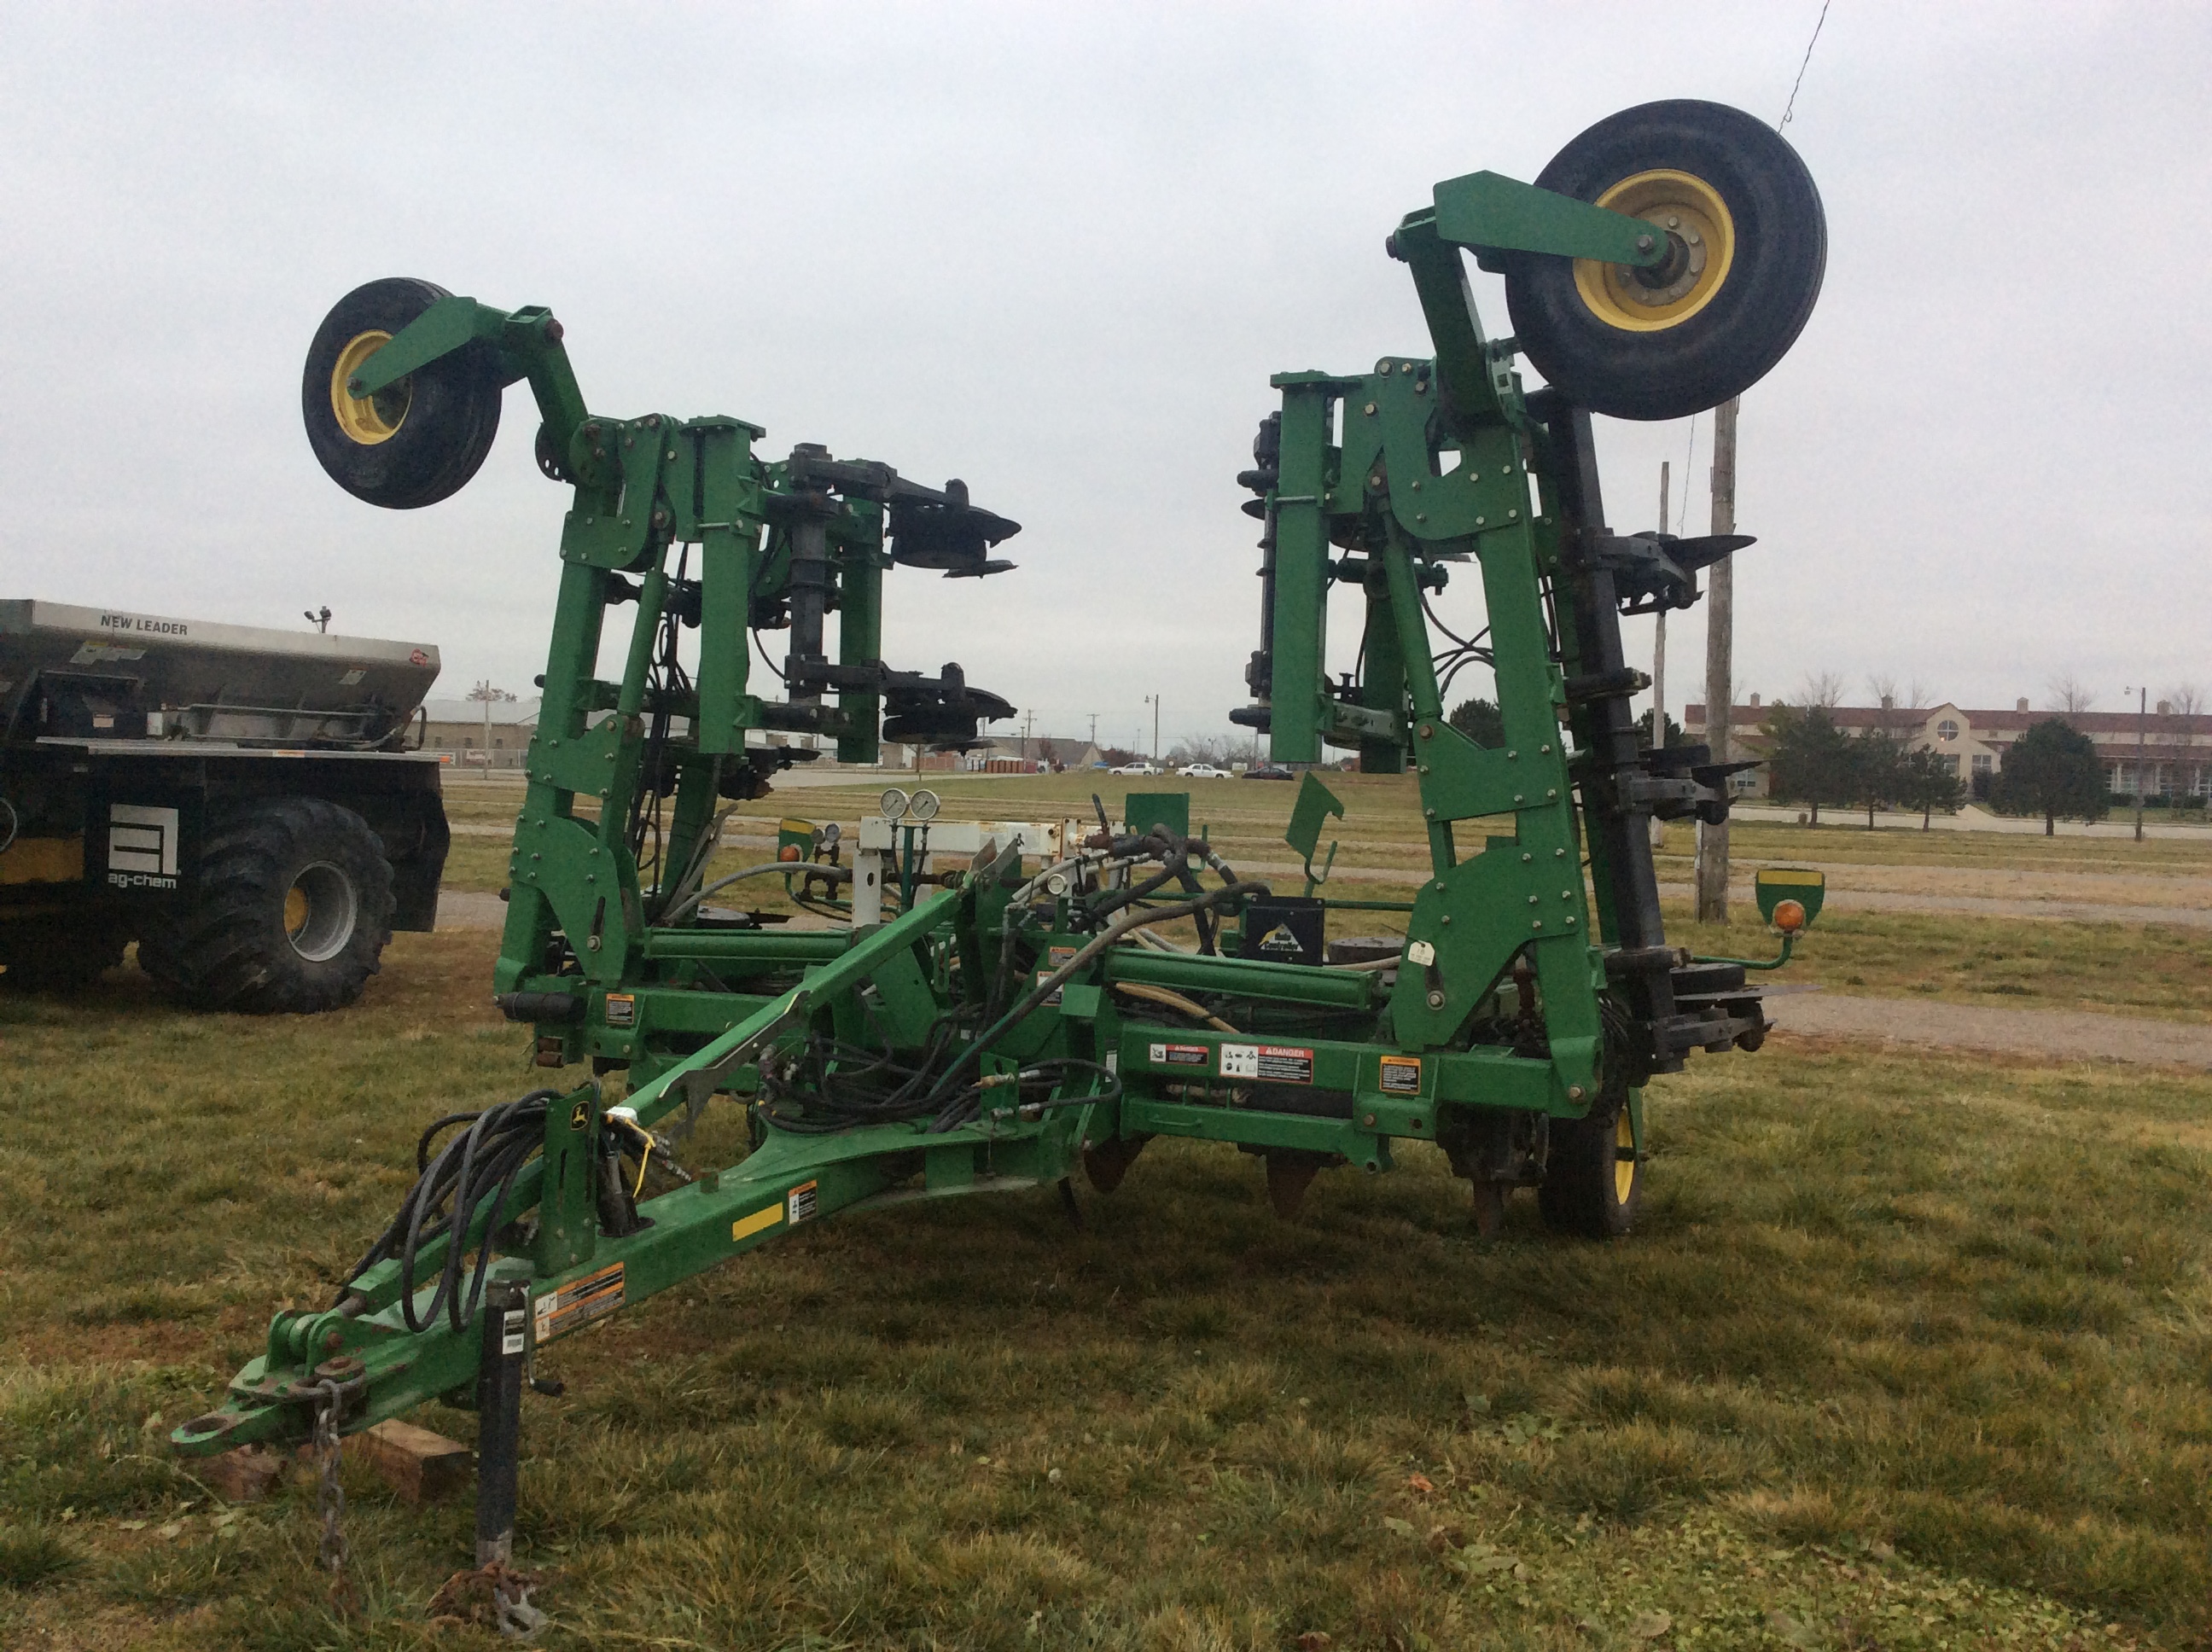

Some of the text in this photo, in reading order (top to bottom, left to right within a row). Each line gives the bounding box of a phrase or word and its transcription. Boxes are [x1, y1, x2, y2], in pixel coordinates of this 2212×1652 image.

[101, 615, 188, 636] NEW LEADER
[108, 873, 177, 889] ag-chem
[1272, 1048, 1305, 1057] DANGER
